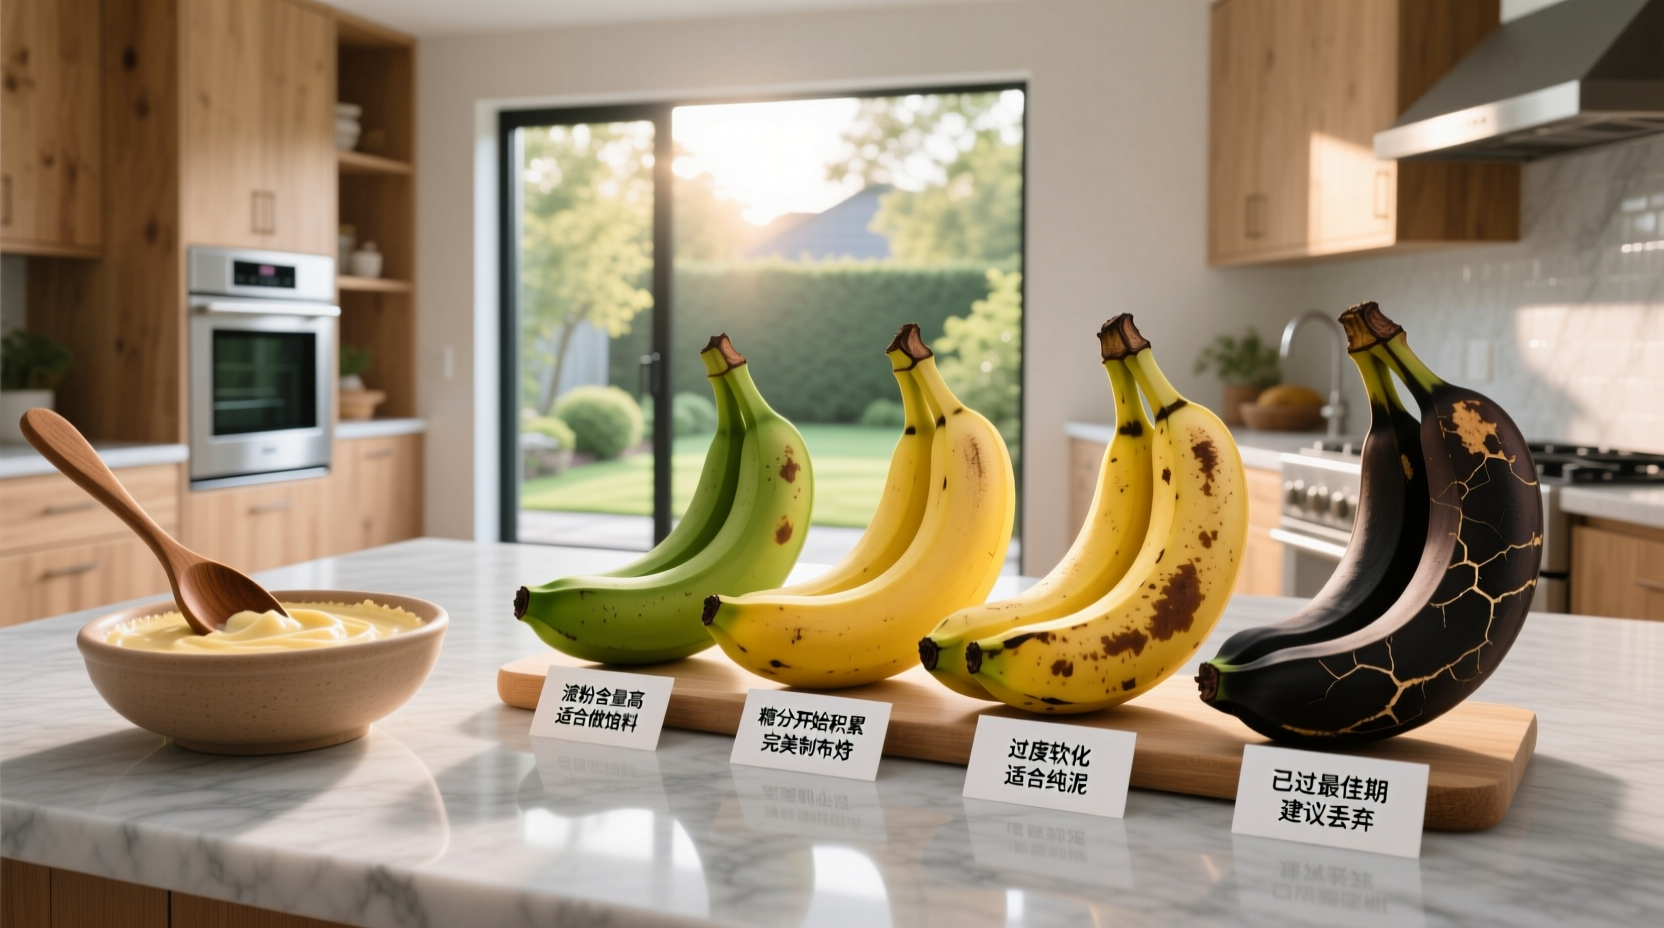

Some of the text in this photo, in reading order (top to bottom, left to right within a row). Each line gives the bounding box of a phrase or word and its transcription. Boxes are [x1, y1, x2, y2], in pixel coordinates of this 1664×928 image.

[757, 706, 866, 736] 糖分开始积累
[1008, 738, 1092, 768] 过度软化
[1004, 764, 1088, 796] 适合纯泥
[1273, 768, 1389, 804] 已过最佳期
[1278, 798, 1375, 833] 建议丢弃
